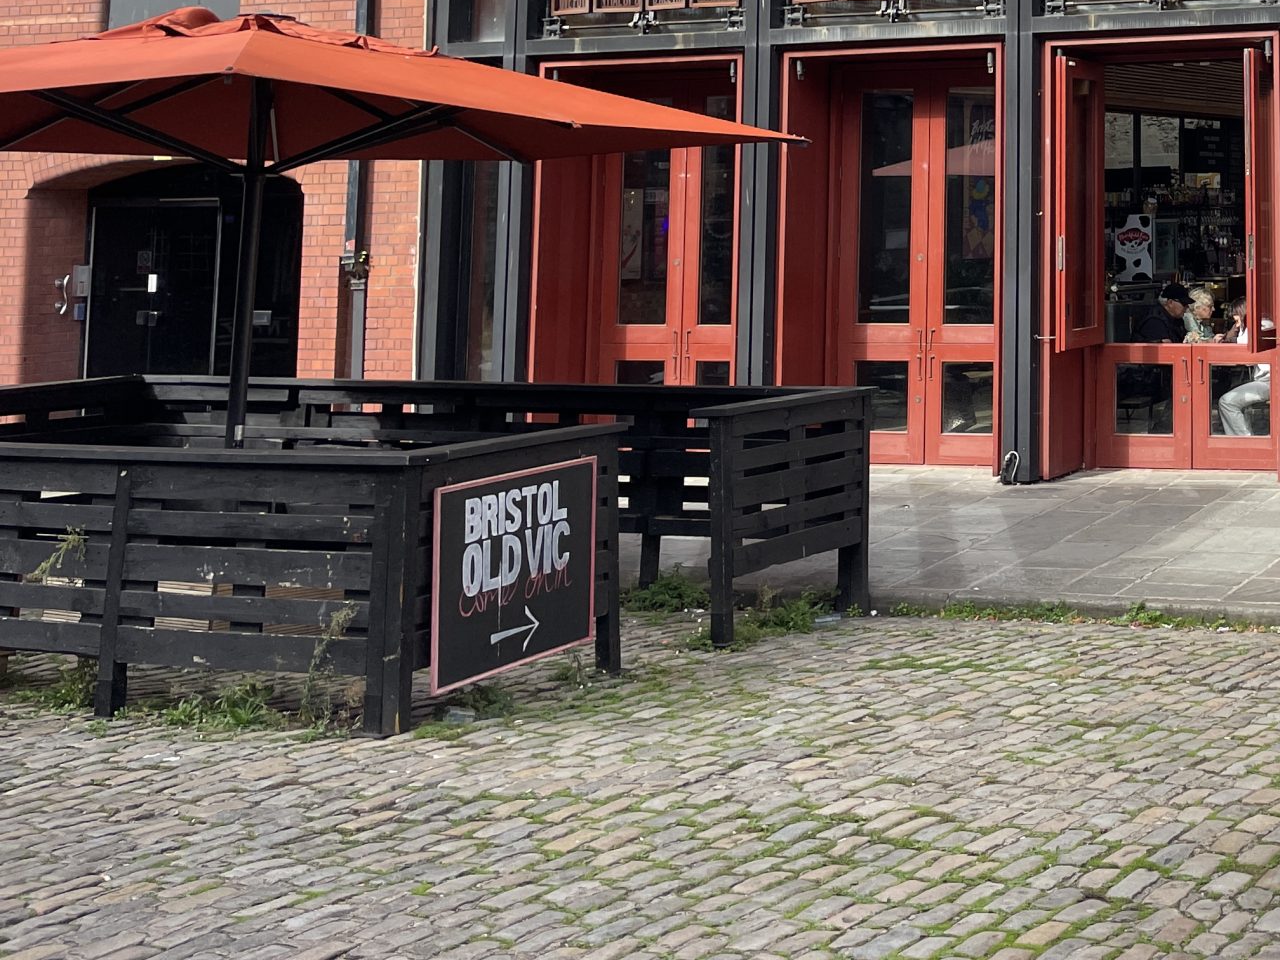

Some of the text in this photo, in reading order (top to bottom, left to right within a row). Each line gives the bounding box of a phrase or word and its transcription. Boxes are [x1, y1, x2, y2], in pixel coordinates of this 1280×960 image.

[464, 480, 569, 544] BRISTOL
[461, 520, 571, 598] OLD VIC
